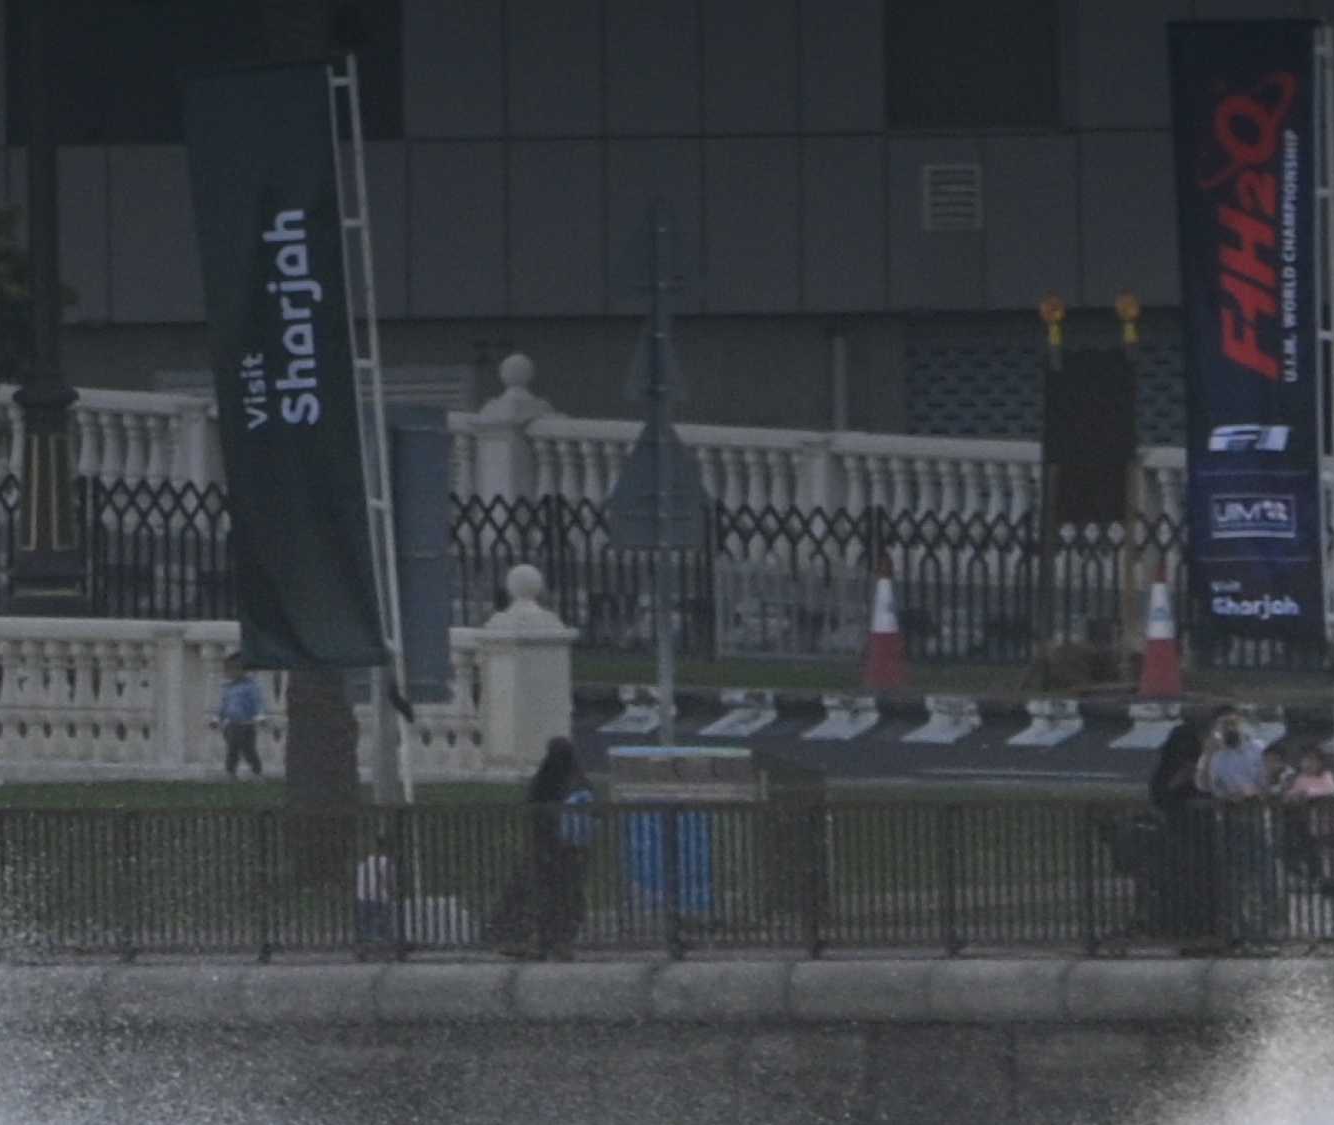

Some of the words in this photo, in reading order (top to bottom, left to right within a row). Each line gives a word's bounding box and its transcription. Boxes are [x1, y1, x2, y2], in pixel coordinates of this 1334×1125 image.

[1281, 127, 1299, 264] CHAMPIONSHIP
[262, 208, 323, 426] Sharjah
[1281, 265, 1297, 329] WORLD
[240, 352, 268, 430] Visit
